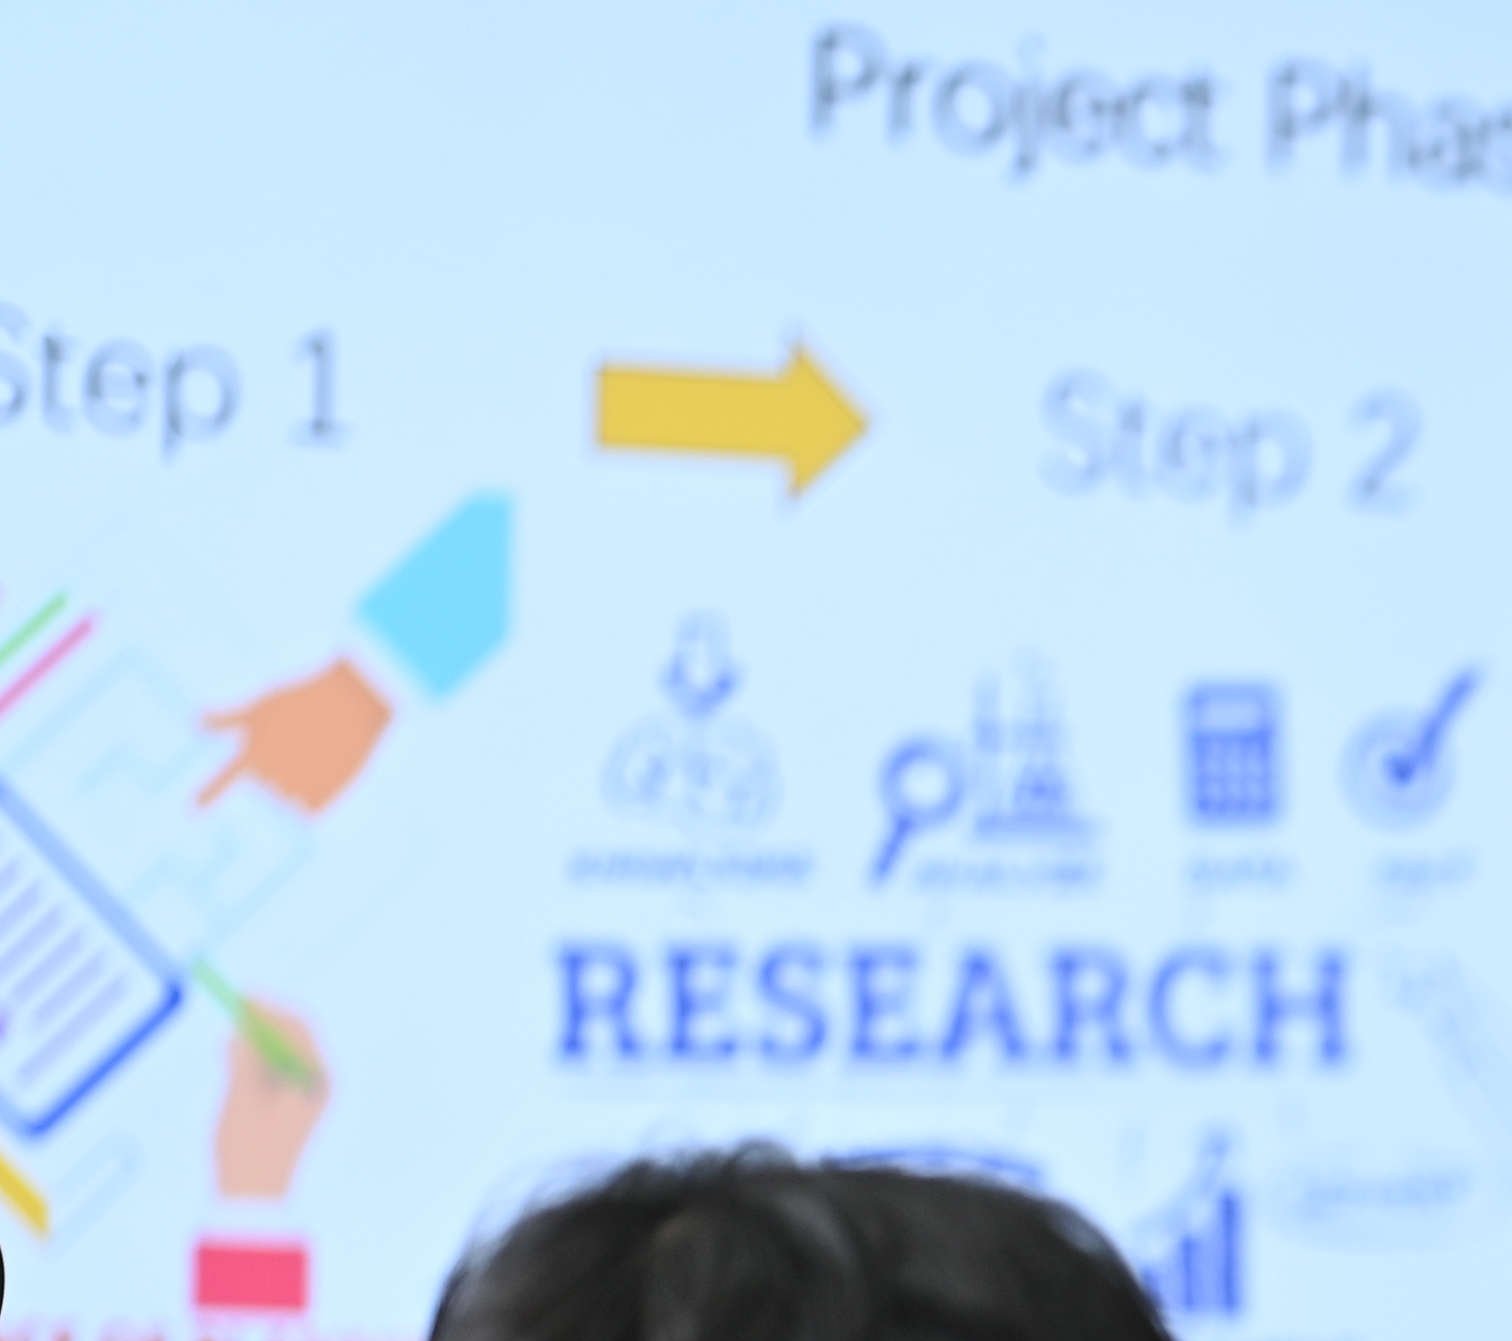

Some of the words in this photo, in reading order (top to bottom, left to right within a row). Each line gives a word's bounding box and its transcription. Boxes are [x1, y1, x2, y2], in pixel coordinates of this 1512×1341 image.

[806, 20, 1223, 184] Project
[290, 326, 348, 450] 1
[1038, 367, 1314, 524] Step
[1345, 386, 1424, 517] 2
[550, 936, 1355, 1075] RESEARCH
